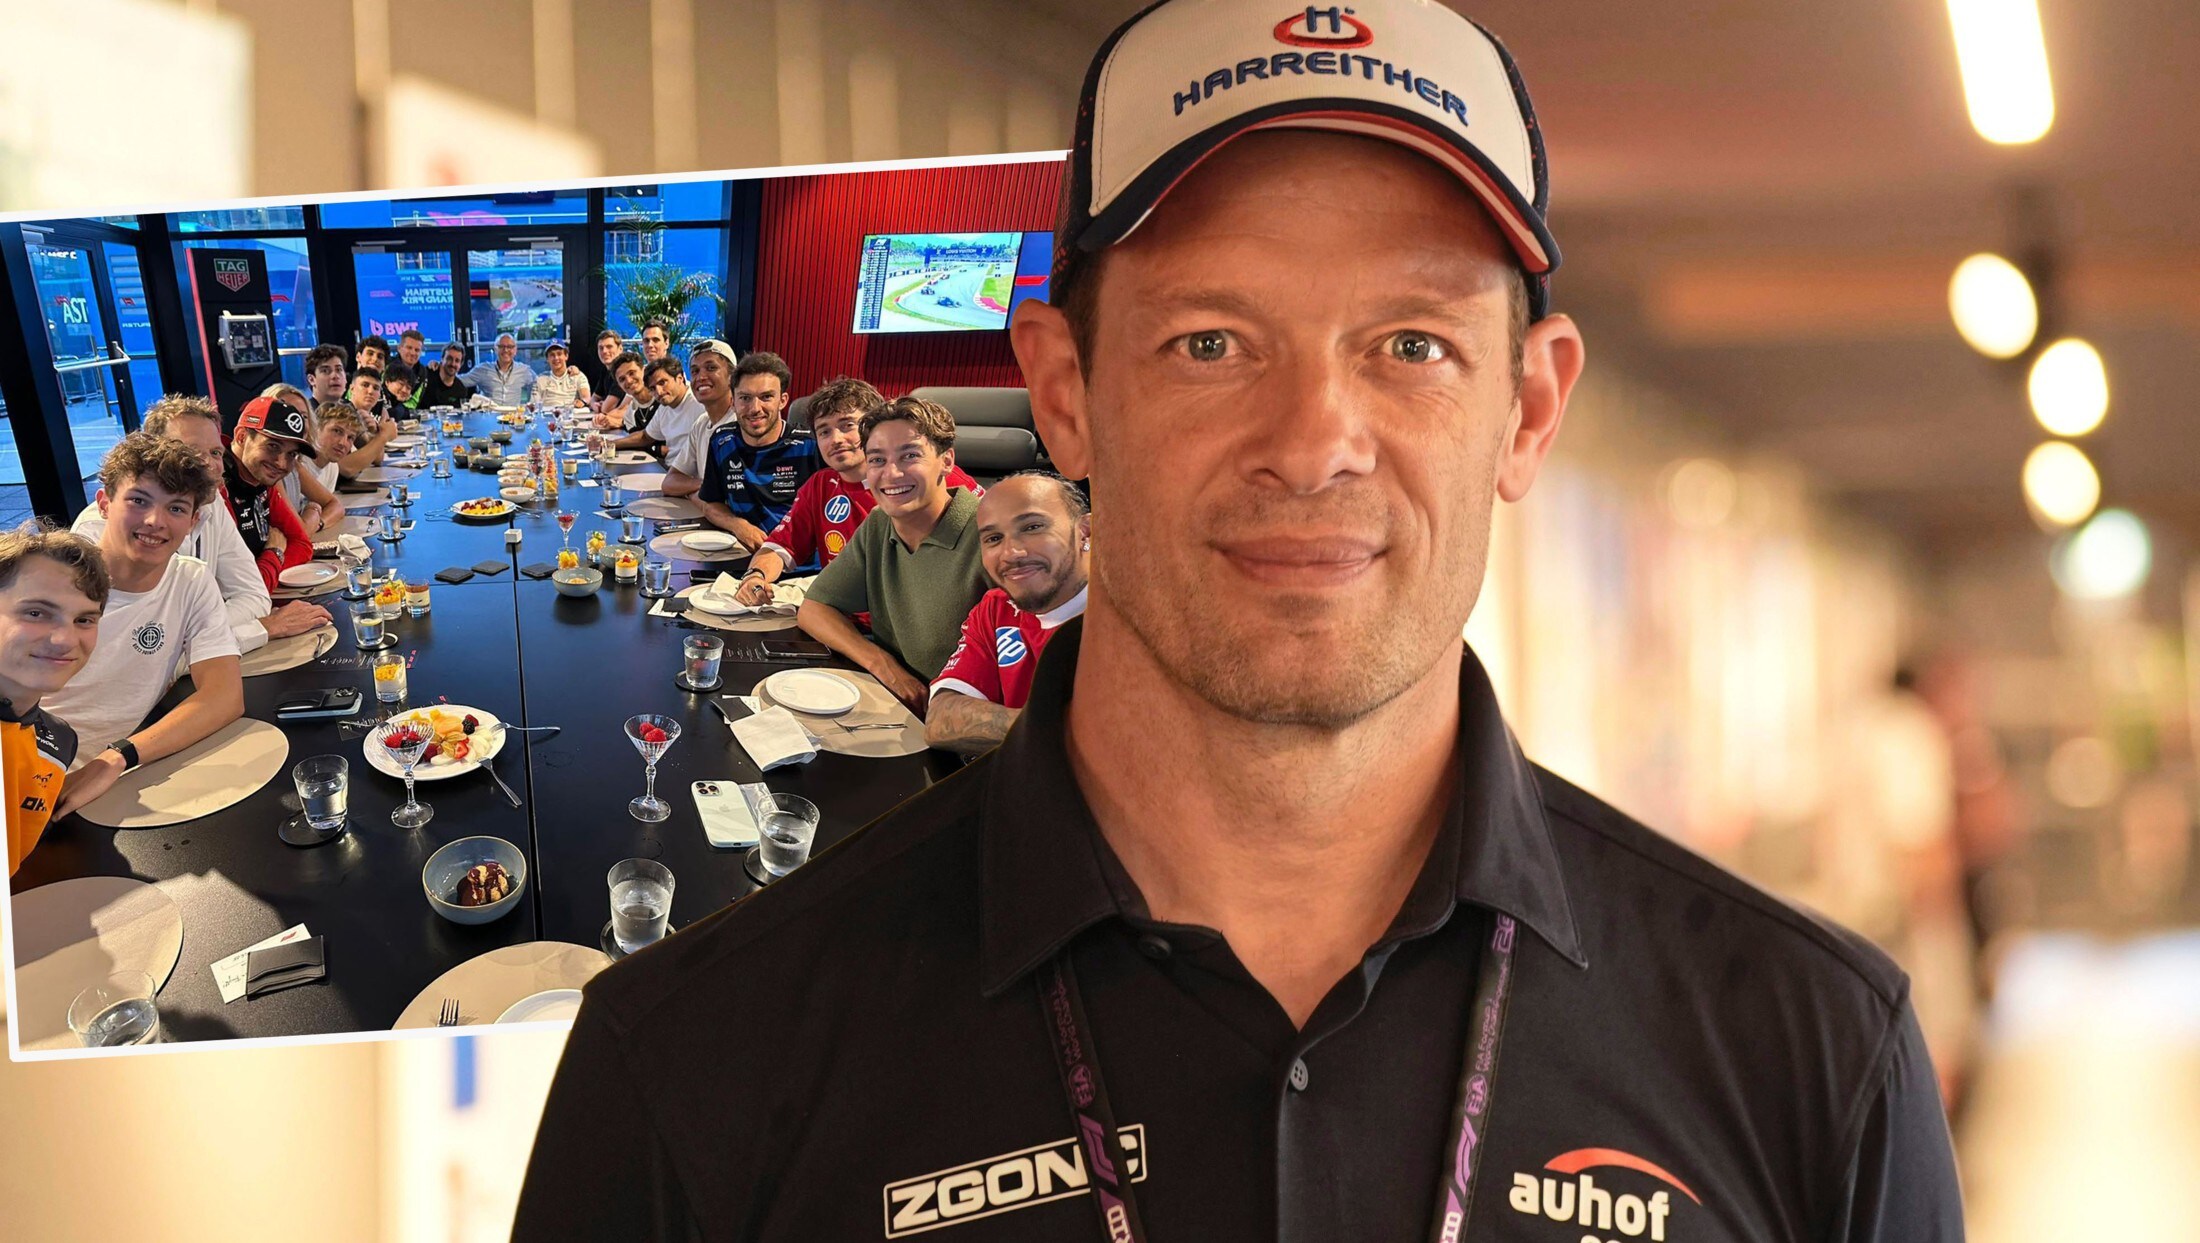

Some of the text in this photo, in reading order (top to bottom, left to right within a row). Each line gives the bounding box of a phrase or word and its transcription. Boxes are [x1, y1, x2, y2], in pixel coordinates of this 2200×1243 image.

[1173, 51, 1469, 127] HARREITHER
[217, 261, 246, 272] TAG
[217, 272, 249, 291] HEUER
[385, 321, 419, 336] BWT
[827, 496, 849, 523] hp
[997, 627, 1027, 665] hp
[40, 738, 60, 752] WORLD
[1465, 1077, 1488, 1115] FIA
[1508, 1171, 1670, 1242] auhof
